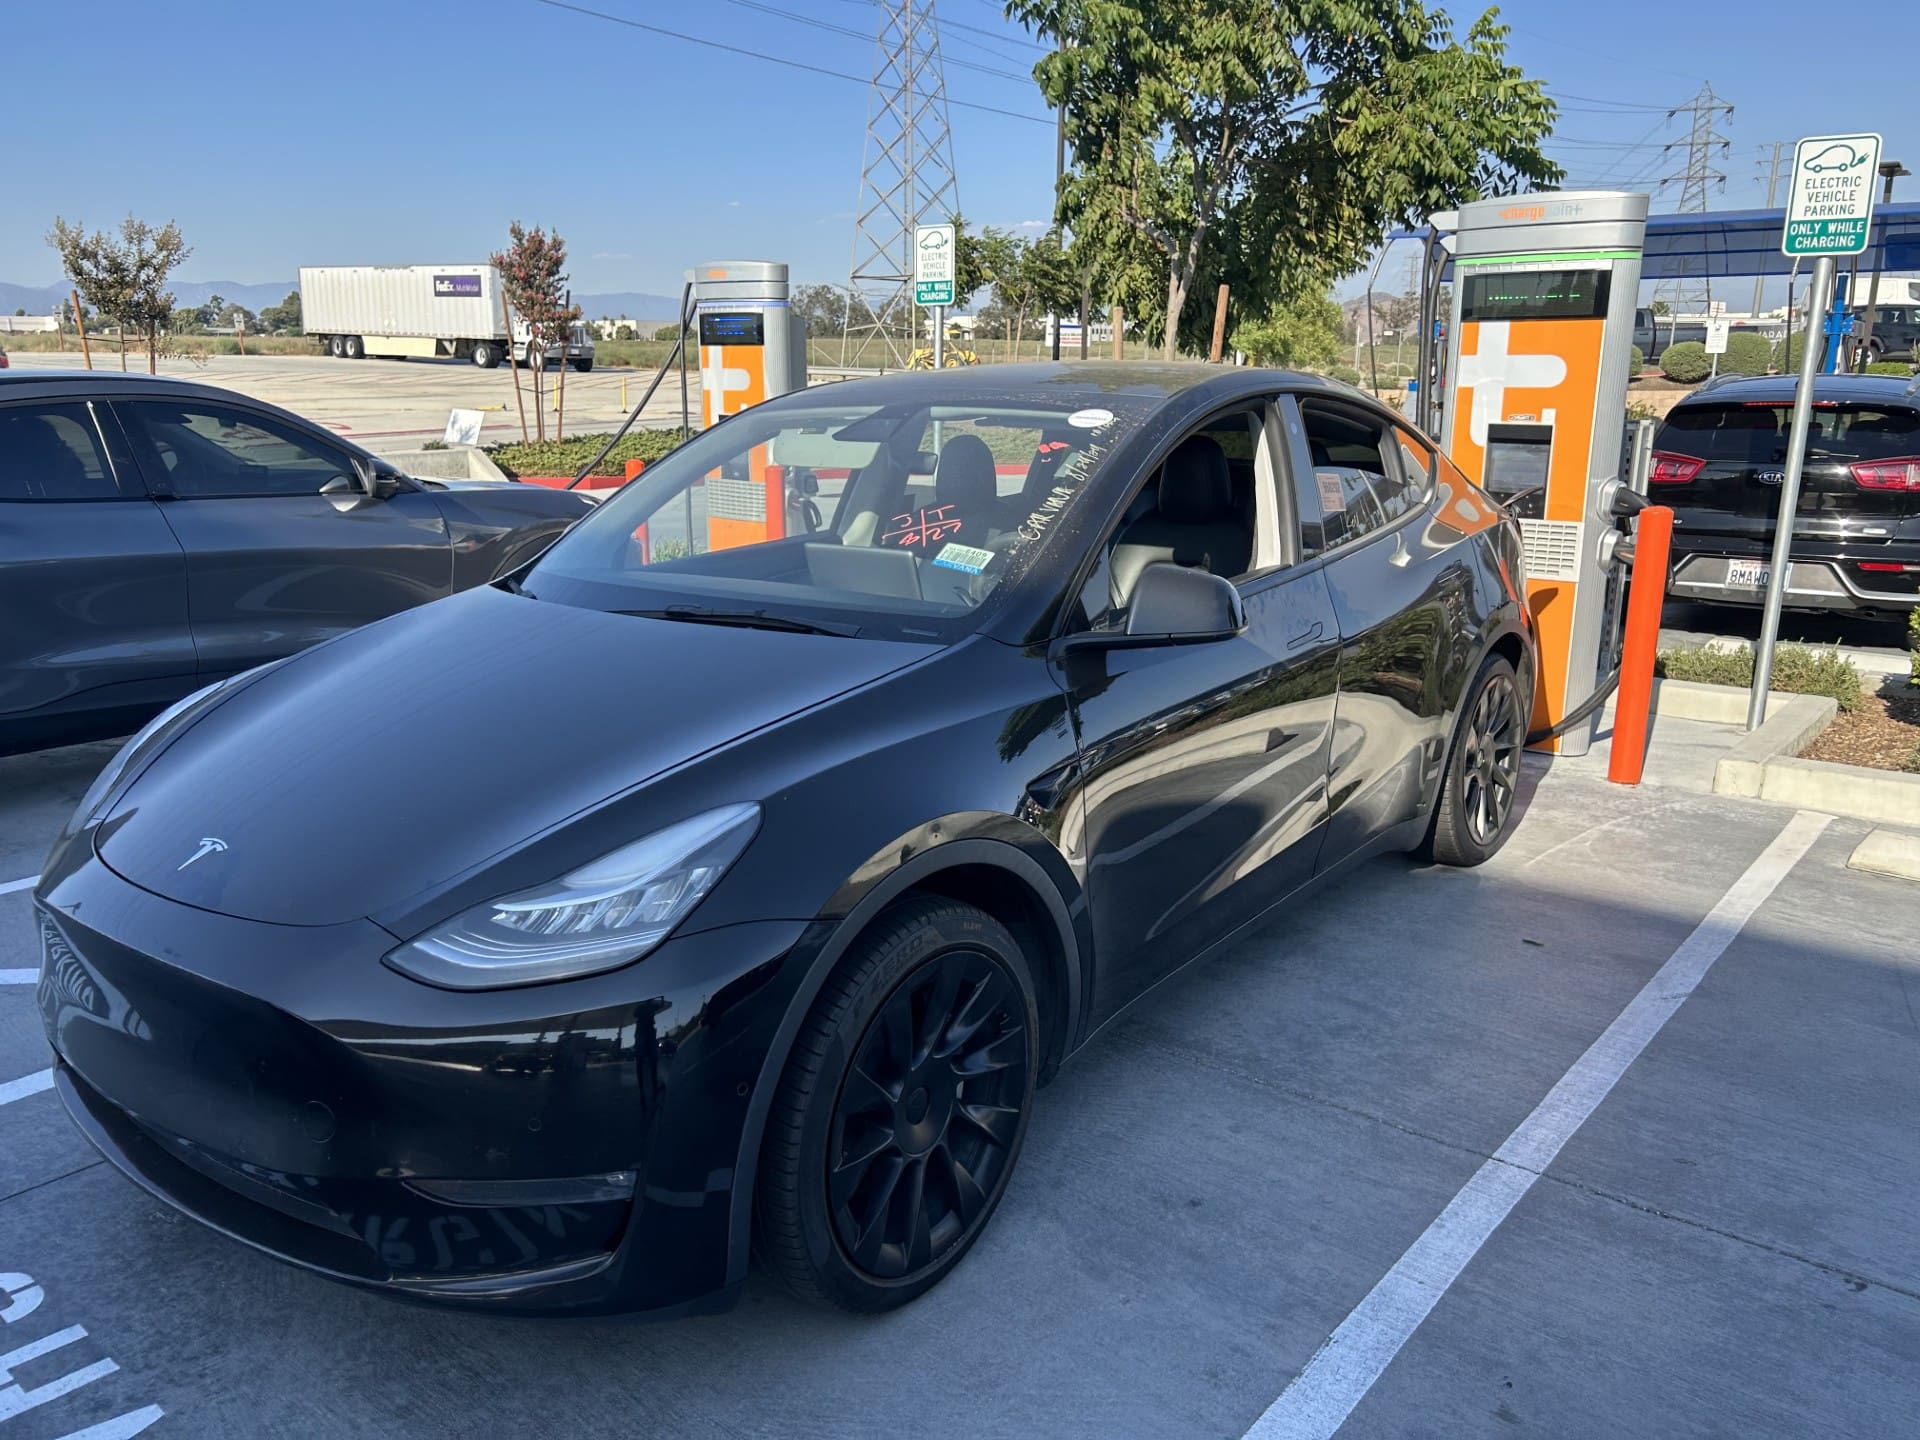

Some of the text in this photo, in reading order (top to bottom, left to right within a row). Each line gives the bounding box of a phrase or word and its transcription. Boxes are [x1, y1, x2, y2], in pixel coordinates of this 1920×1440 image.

[1805, 176, 1862, 189] ELECTRIC
[1807, 190, 1856, 203] VEHICLE
[1804, 204, 1855, 216] PARKING
[1790, 221, 1864, 235] ONLY WHILE
[1795, 235, 1855, 249] CHARGING
[921, 252, 948, 262] ELECTRIC
[923, 262, 946, 270] VEHICLE
[923, 271, 946, 279] PARKING
[917, 282, 952, 292] ONLY WHILE
[920, 292, 949, 301] CHARGING
[1764, 472, 1782, 483] KIA
